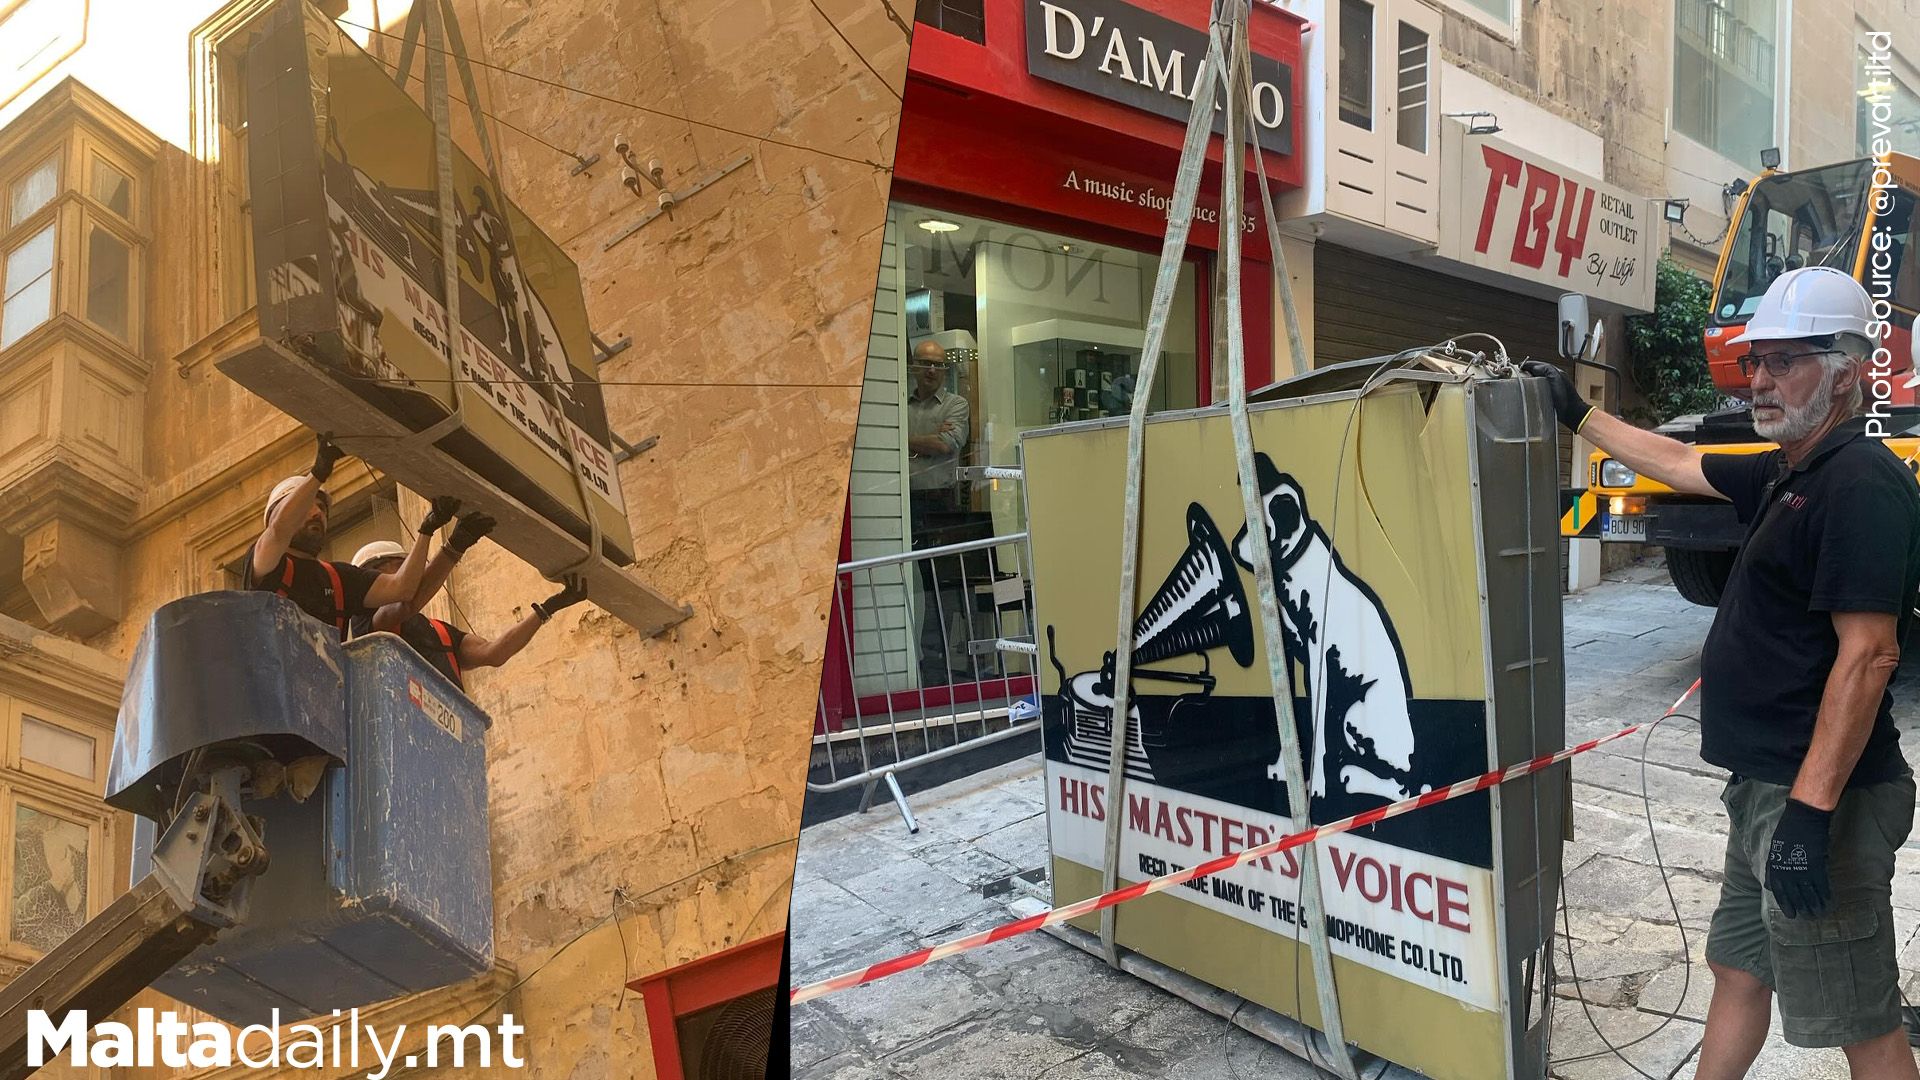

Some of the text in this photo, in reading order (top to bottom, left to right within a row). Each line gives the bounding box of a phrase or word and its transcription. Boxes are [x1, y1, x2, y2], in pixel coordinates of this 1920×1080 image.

[1039, 1, 1284, 129] D'AMO
[1063, 170, 1080, 190] A
[1083, 178, 1134, 203] music
[1192, 205, 1216, 223] nce
[1474, 143, 1596, 278] TBY
[1601, 193, 1634, 220] RETAIL
[1600, 218, 1638, 245] OUTLET
[1587, 253, 1636, 287] By Luigi
[440, 340, 470, 377] TRE
[496, 391, 508, 408] OF
[509, 401, 527, 426] THE
[1611, 519, 1630, 535] BCU
[437, 703, 456, 734] 200
[1058, 776, 1471, 934] HIS MASTER'S VOICE
[1212, 877, 1245, 907] MARK
[1248, 889, 1265, 912] OF
[1269, 895, 1296, 925] THE
[1300, 905, 1396, 960] GMOPHONE
